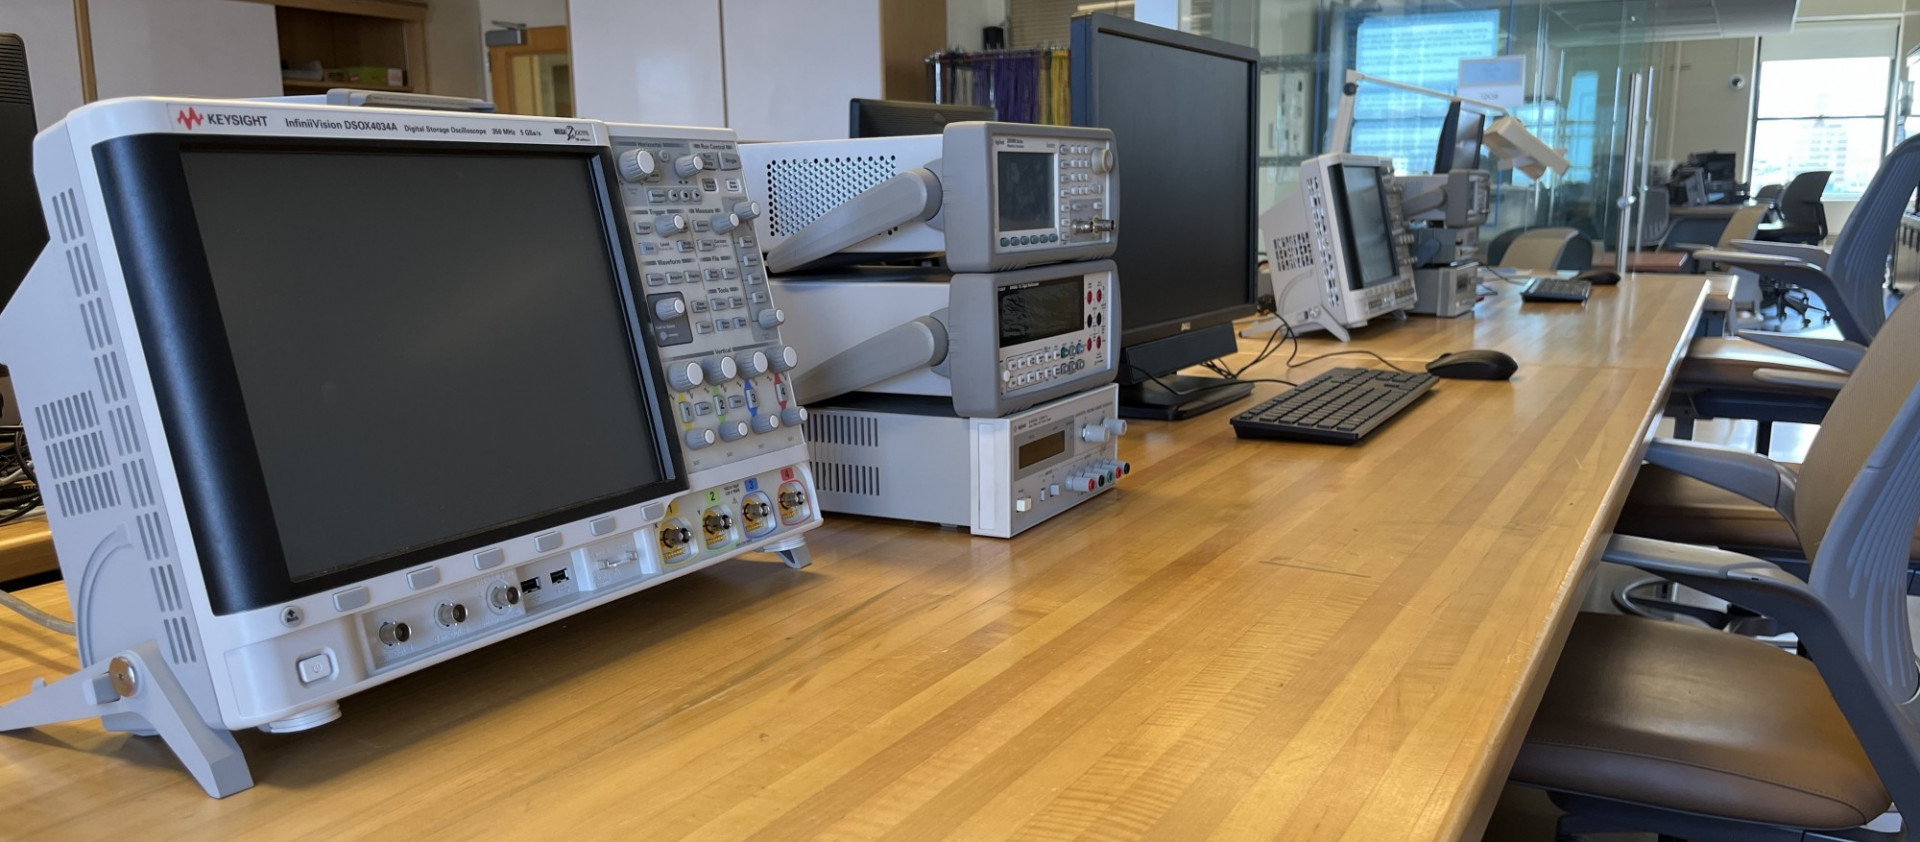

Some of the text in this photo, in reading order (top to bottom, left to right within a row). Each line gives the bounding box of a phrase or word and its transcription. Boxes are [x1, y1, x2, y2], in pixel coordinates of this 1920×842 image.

[207, 114, 268, 127] KEYSIGHT
[285, 118, 398, 131] InfiniiVision DSOX4034A
[404, 124, 487, 136] Digital Storage Oscilloscope
[649, 208, 666, 216] Trigger
[714, 347, 732, 355] Vertical
[781, 387, 786, 396] 4
[751, 394, 756, 403] 3
[719, 399, 725, 409] 2
[784, 469, 790, 478] 4
[748, 480, 754, 490] 3
[710, 491, 716, 501] 2
